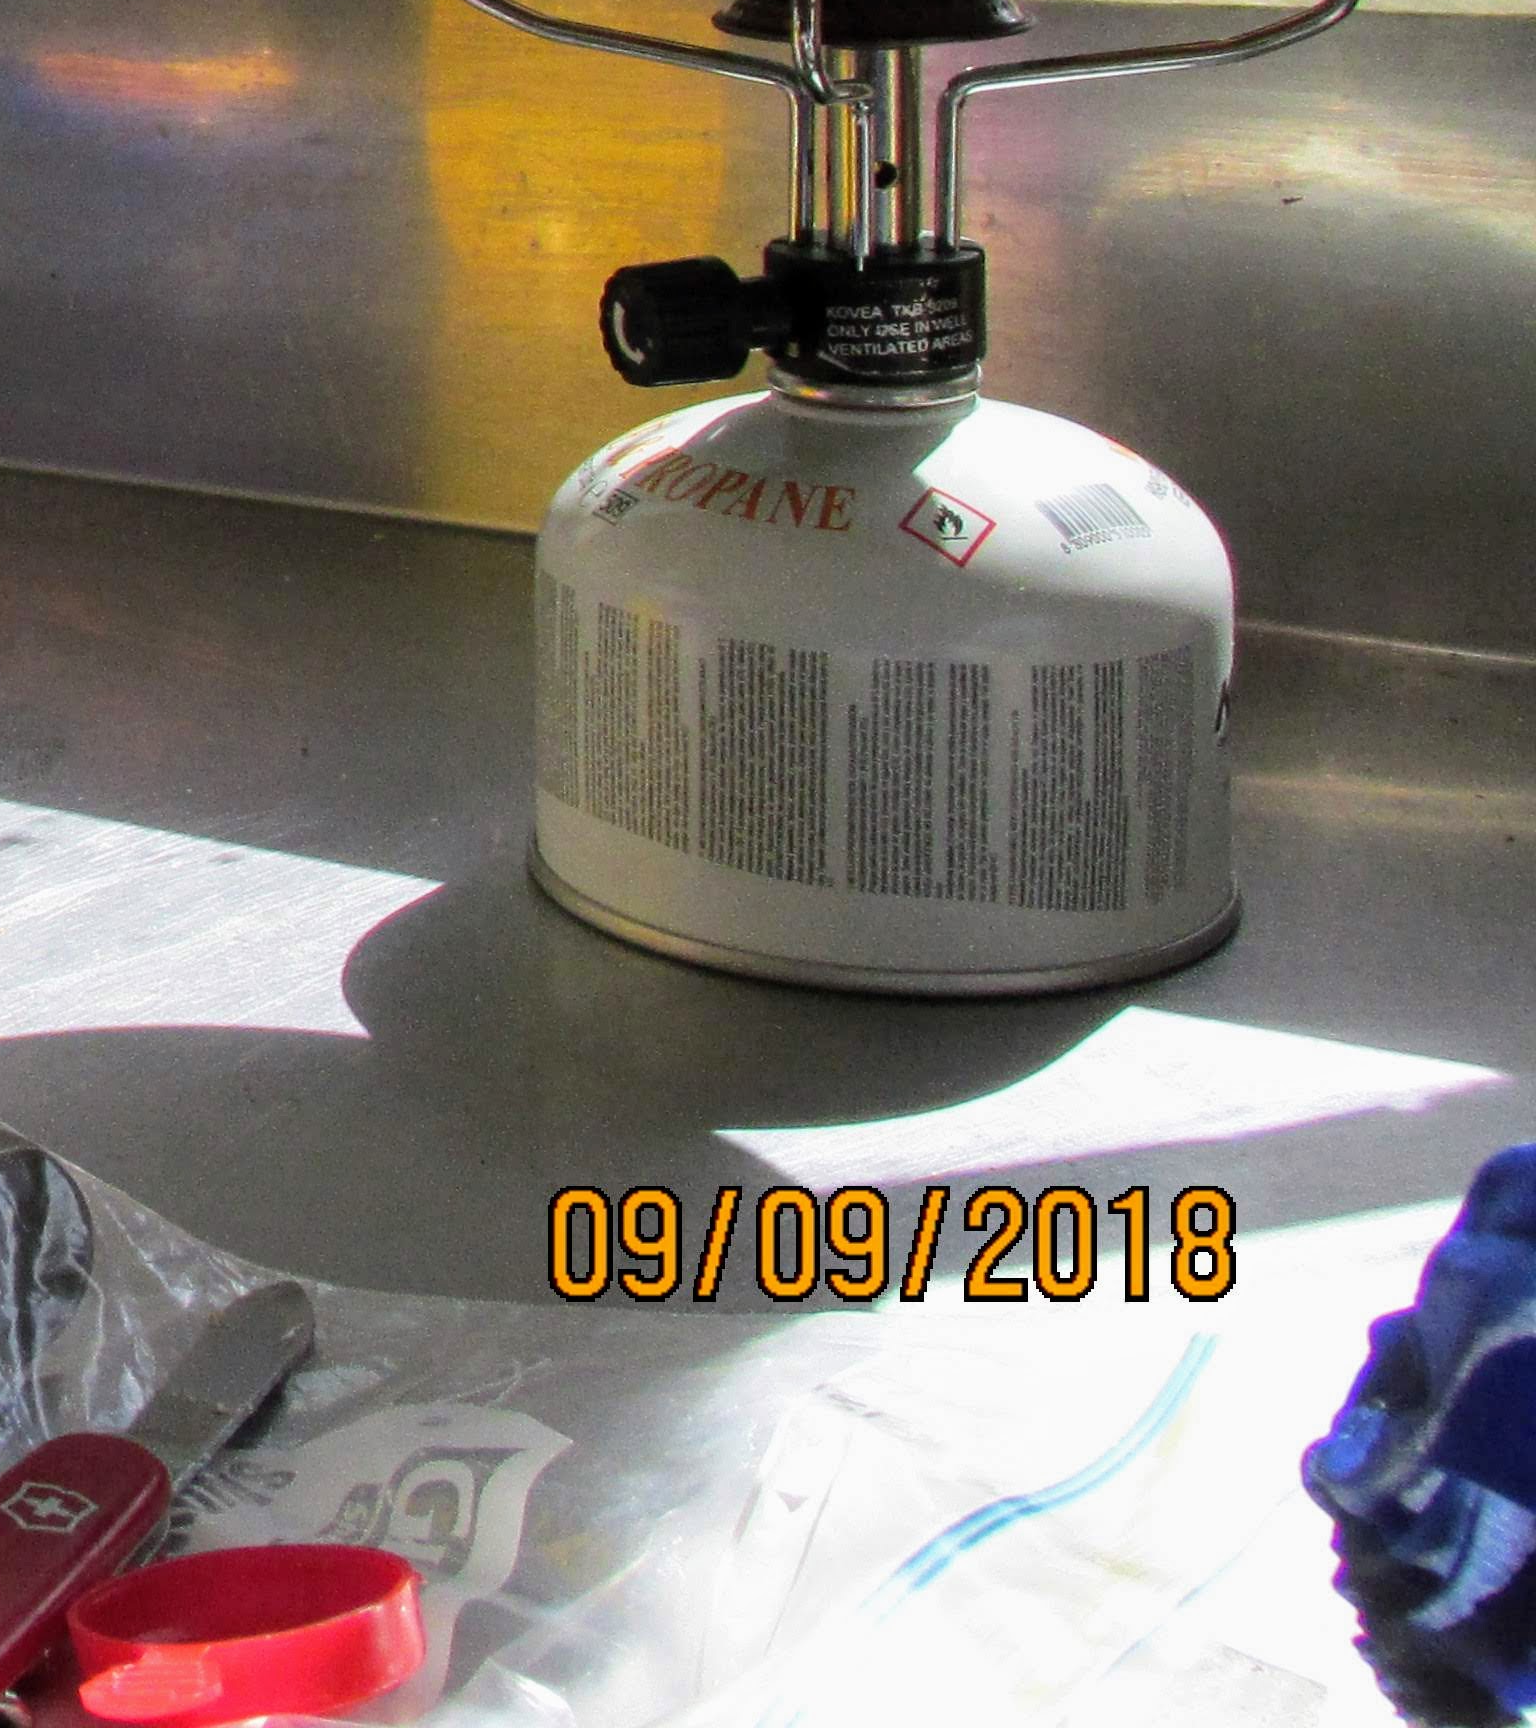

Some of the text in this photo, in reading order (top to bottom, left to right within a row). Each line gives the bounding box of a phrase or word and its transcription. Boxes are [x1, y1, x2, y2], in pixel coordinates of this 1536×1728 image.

[826, 305, 883, 320] KOVEA
[828, 323, 869, 338] ONLY
[914, 321, 929, 334] IN
[929, 314, 968, 332] WELL
[828, 330, 974, 356] VENTILATED AREAS
